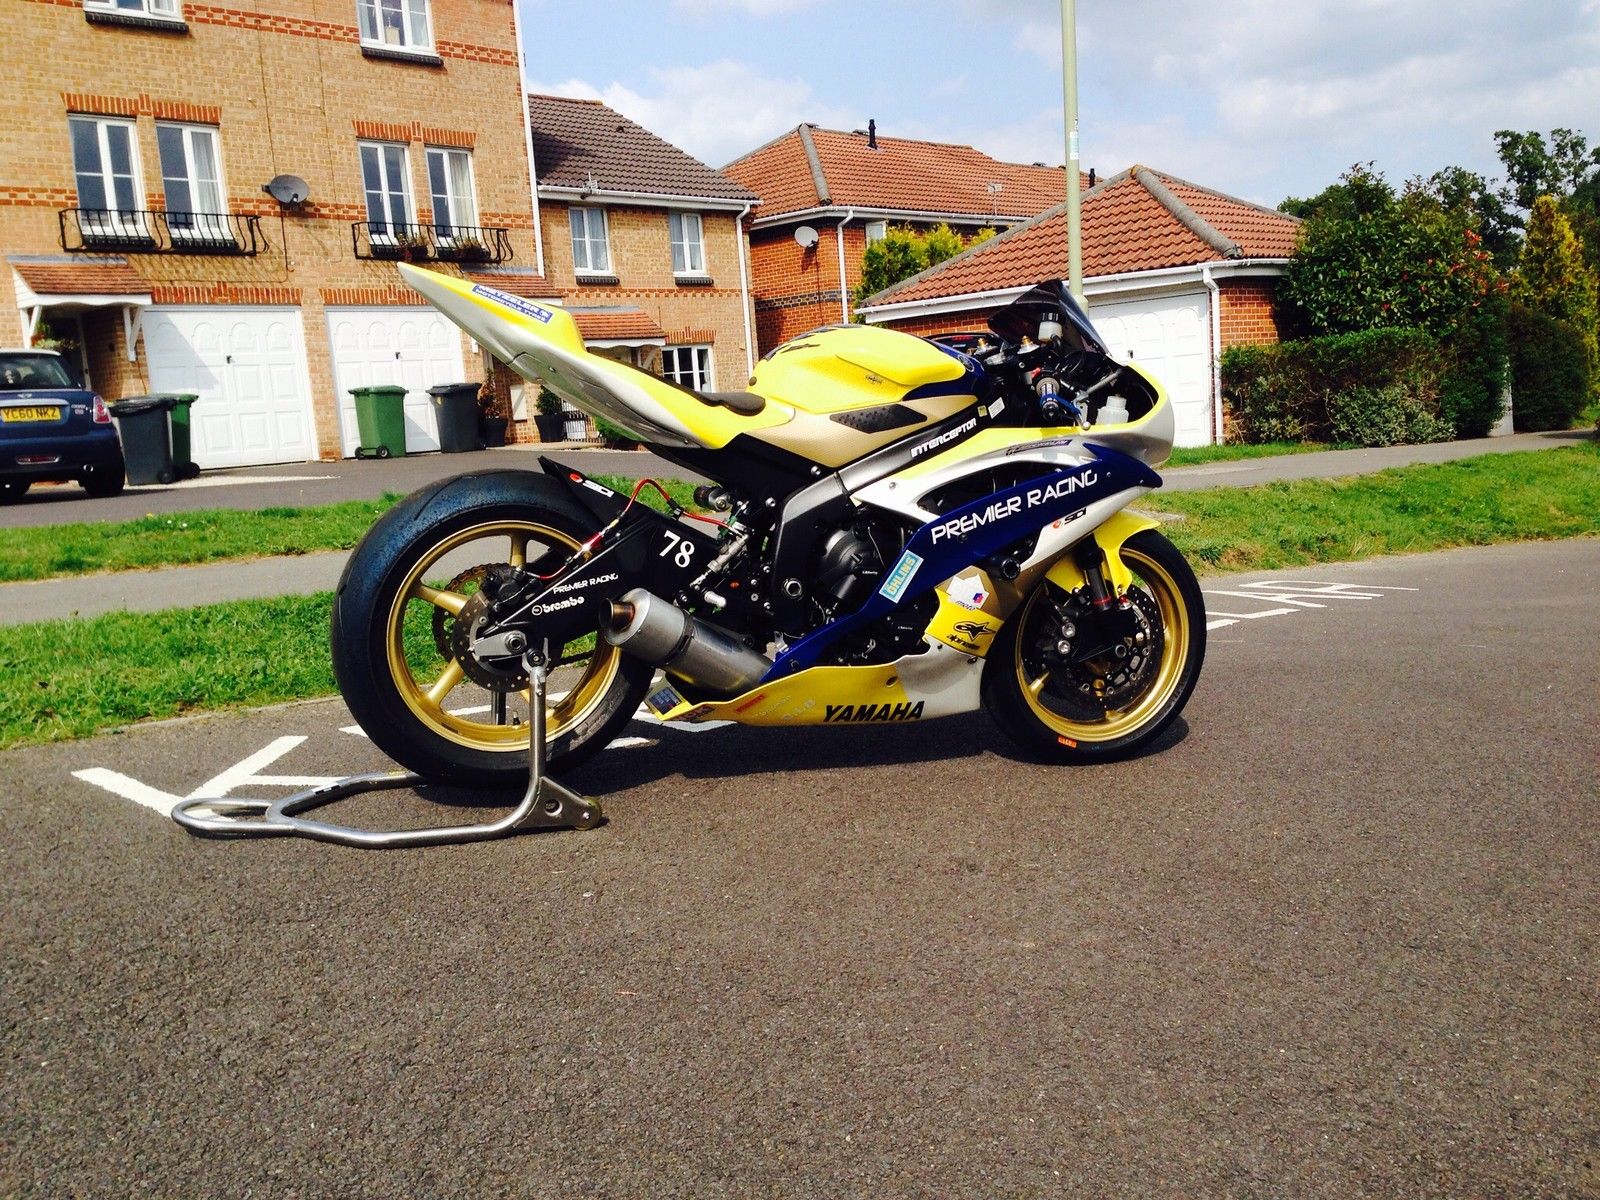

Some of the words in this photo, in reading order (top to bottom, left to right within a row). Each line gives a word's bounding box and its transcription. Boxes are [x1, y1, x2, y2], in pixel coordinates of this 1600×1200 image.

[4, 408, 34, 419] YC60
[36, 407, 59, 418] NKZ
[911, 417, 977, 458] INTERCEPTOR
[931, 496, 1022, 545] PREMIER
[1027, 469, 1098, 509] RACING
[659, 530, 695, 568] 78
[553, 580, 589, 594] PREMIER
[589, 573, 619, 586] RACING
[542, 596, 585, 613] brembo
[823, 701, 925, 722] YAMAHA
